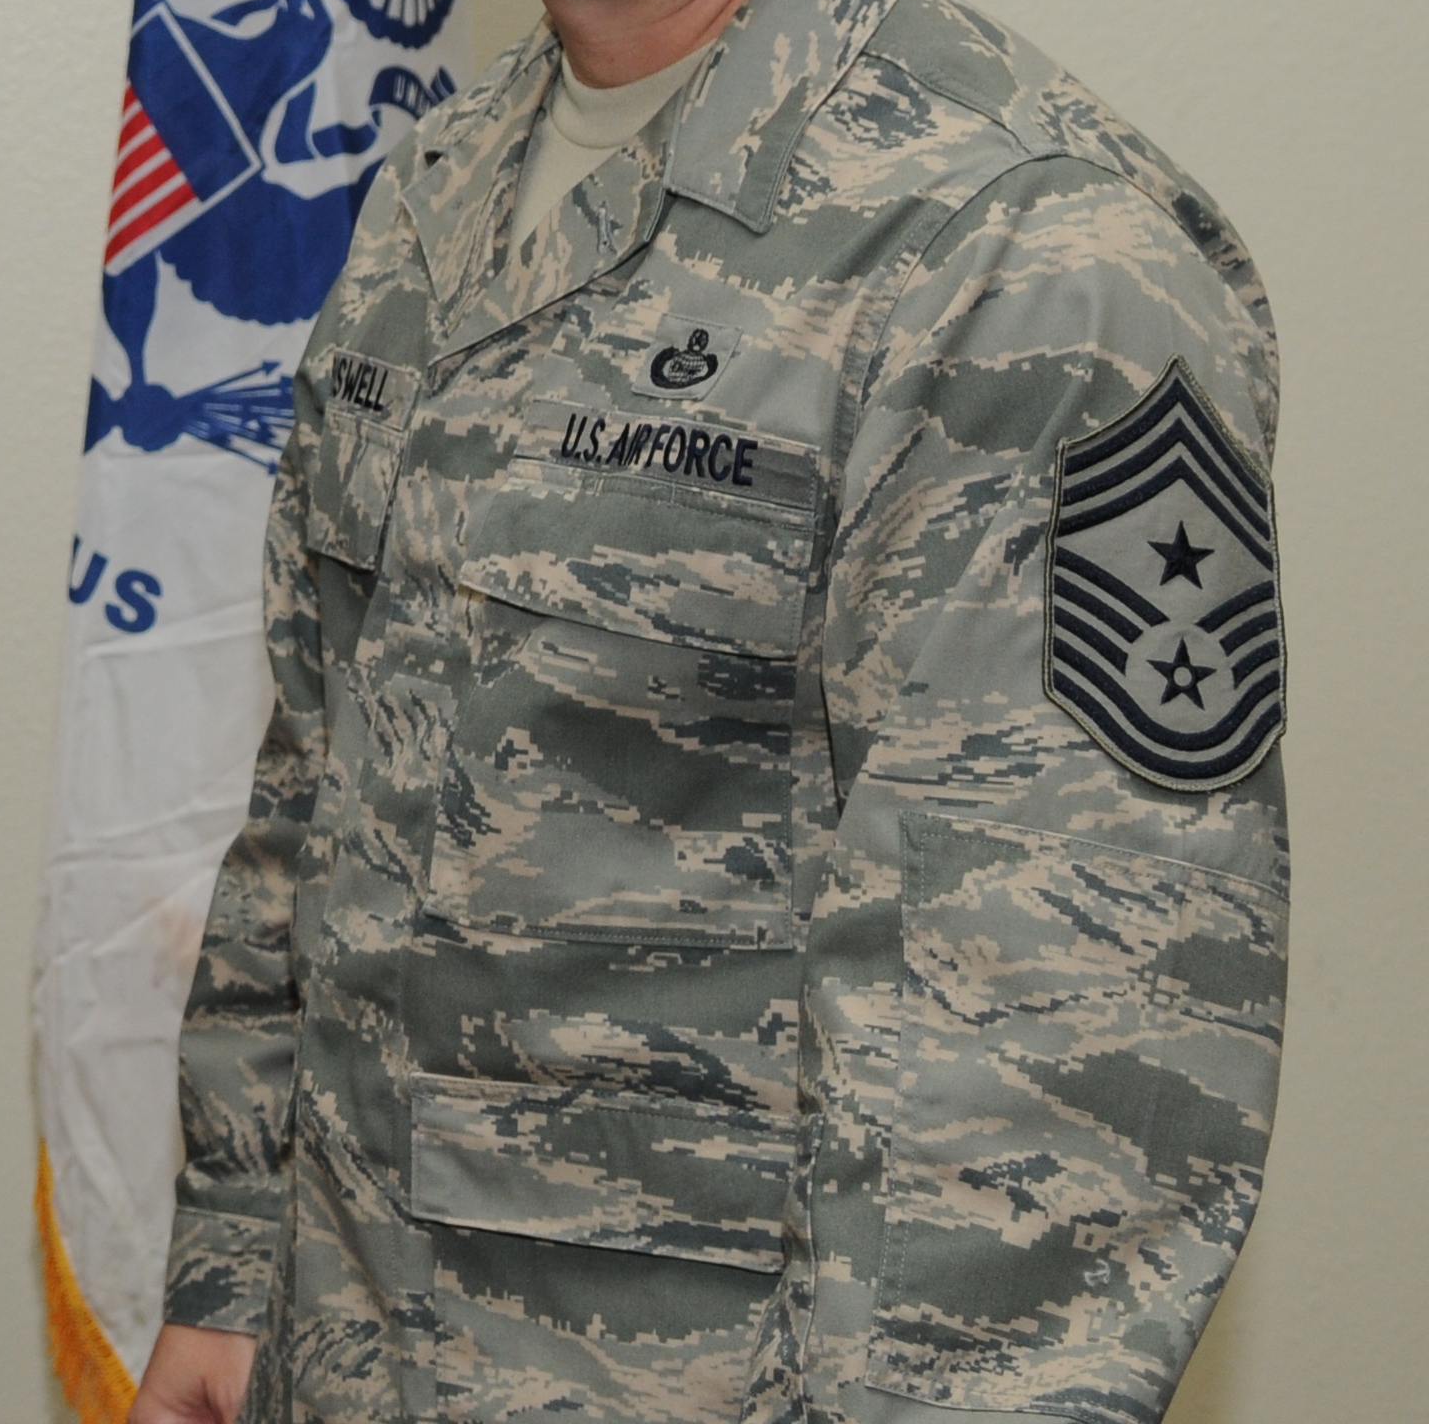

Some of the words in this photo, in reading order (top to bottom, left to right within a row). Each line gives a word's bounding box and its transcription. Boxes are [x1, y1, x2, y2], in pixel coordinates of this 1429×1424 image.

[332, 357, 389, 412] SWELL
[560, 413, 607, 463] U.S.
[605, 422, 653, 466] AIR
[643, 423, 759, 487] FORCE
